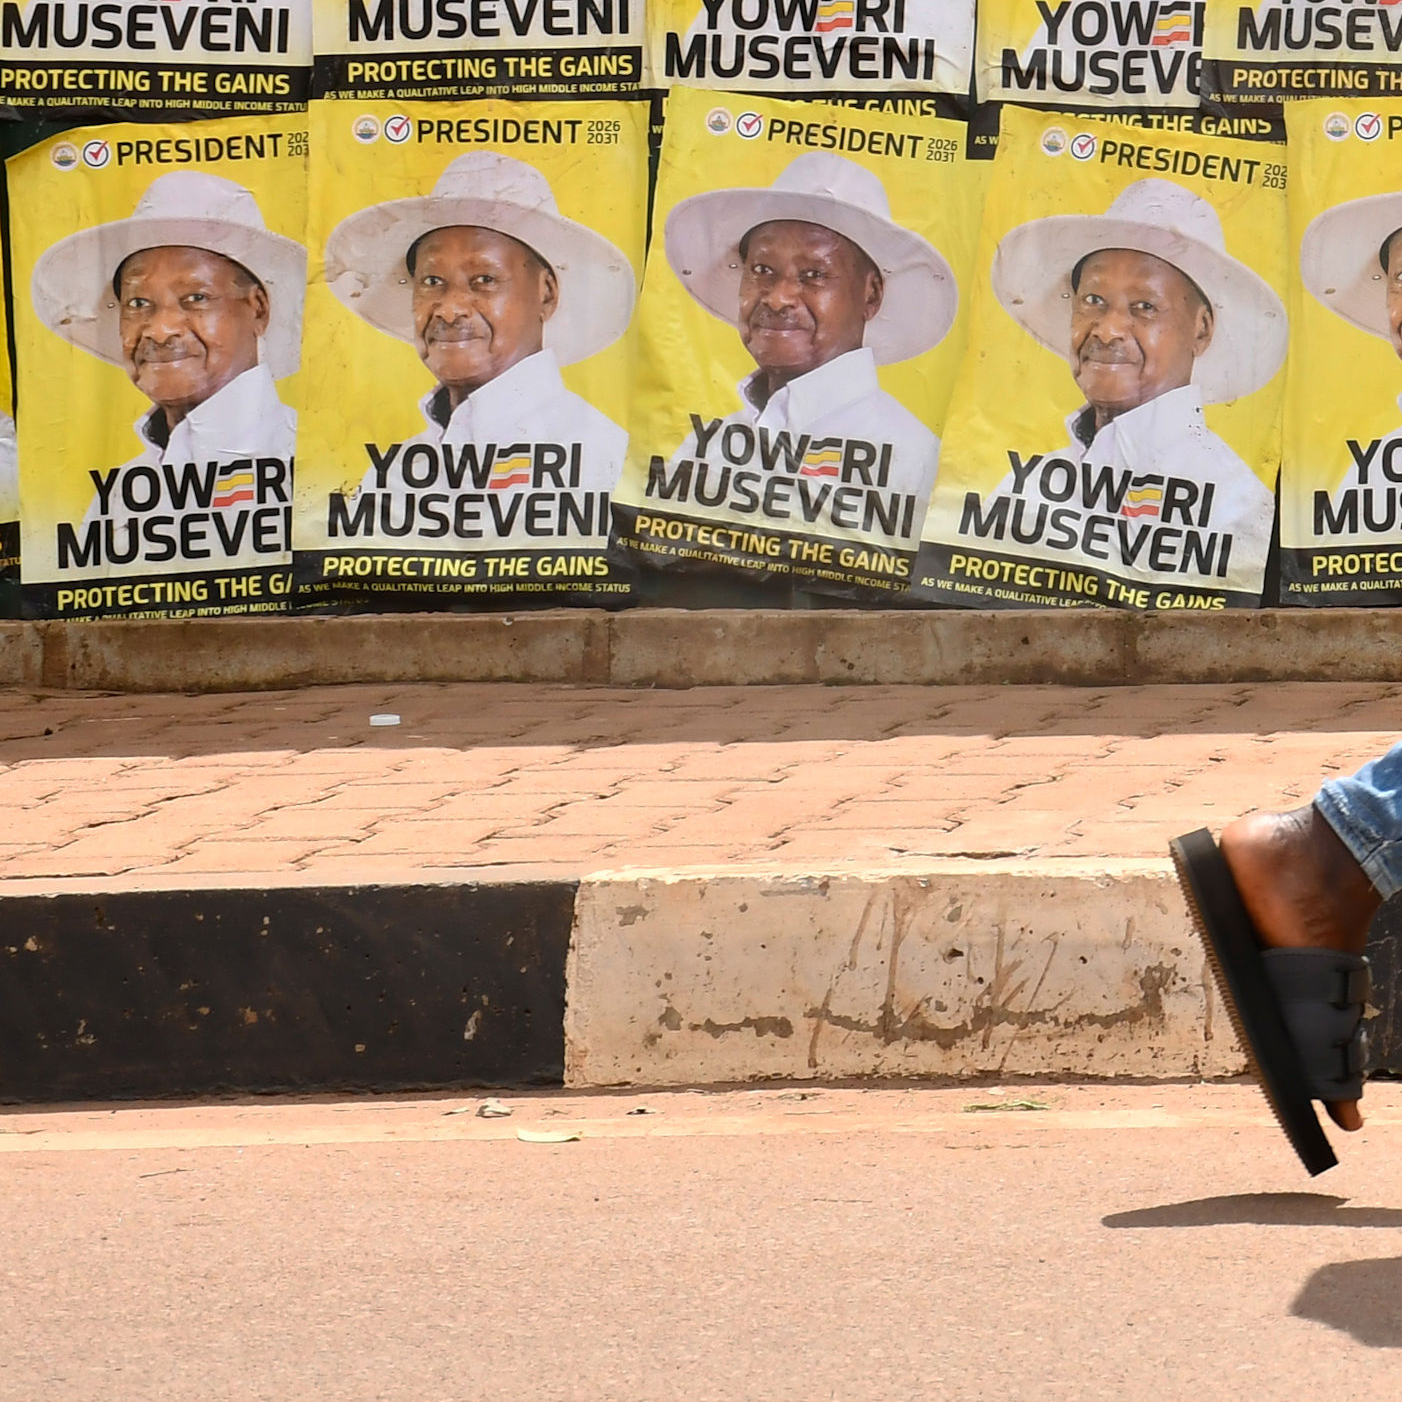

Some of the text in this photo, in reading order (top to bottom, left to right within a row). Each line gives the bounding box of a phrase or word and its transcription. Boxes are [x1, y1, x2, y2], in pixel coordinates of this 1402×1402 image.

[3, 3, 289, 53] MUSEVENI
[348, 55, 633, 84] PROTECTING THE GAINS
[665, 33, 934, 81] MUSEVENI
[417, 119, 583, 144] PRESIDENT
[587, 121, 620, 132] 2026
[587, 133, 619, 144] 2031
[768, 118, 924, 159] PRESIDENT
[926, 149, 956, 163] 2031
[927, 137, 958, 152] 2026
[365, 443, 582, 490] YOWERI
[1007, 451, 1215, 528] YOWERI
[329, 492, 609, 539] MUSEVENI
[635, 516, 909, 576] PROTECTING THE GAINS
[958, 493, 1233, 577] MUSEVENI
[324, 556, 609, 578] PROTECTING THE GAINS
[298, 585, 311, 593] AS
[313, 583, 329, 591] WE
[333, 582, 359, 590] MAKE
[371, 583, 434, 592] QUALITATIVE
[464, 584, 487, 592] INTO
[490, 584, 513, 592] HIGH
[516, 583, 552, 591] MIDDLE
[556, 583, 593, 591] INCOME
[595, 584, 631, 593] STATUS
